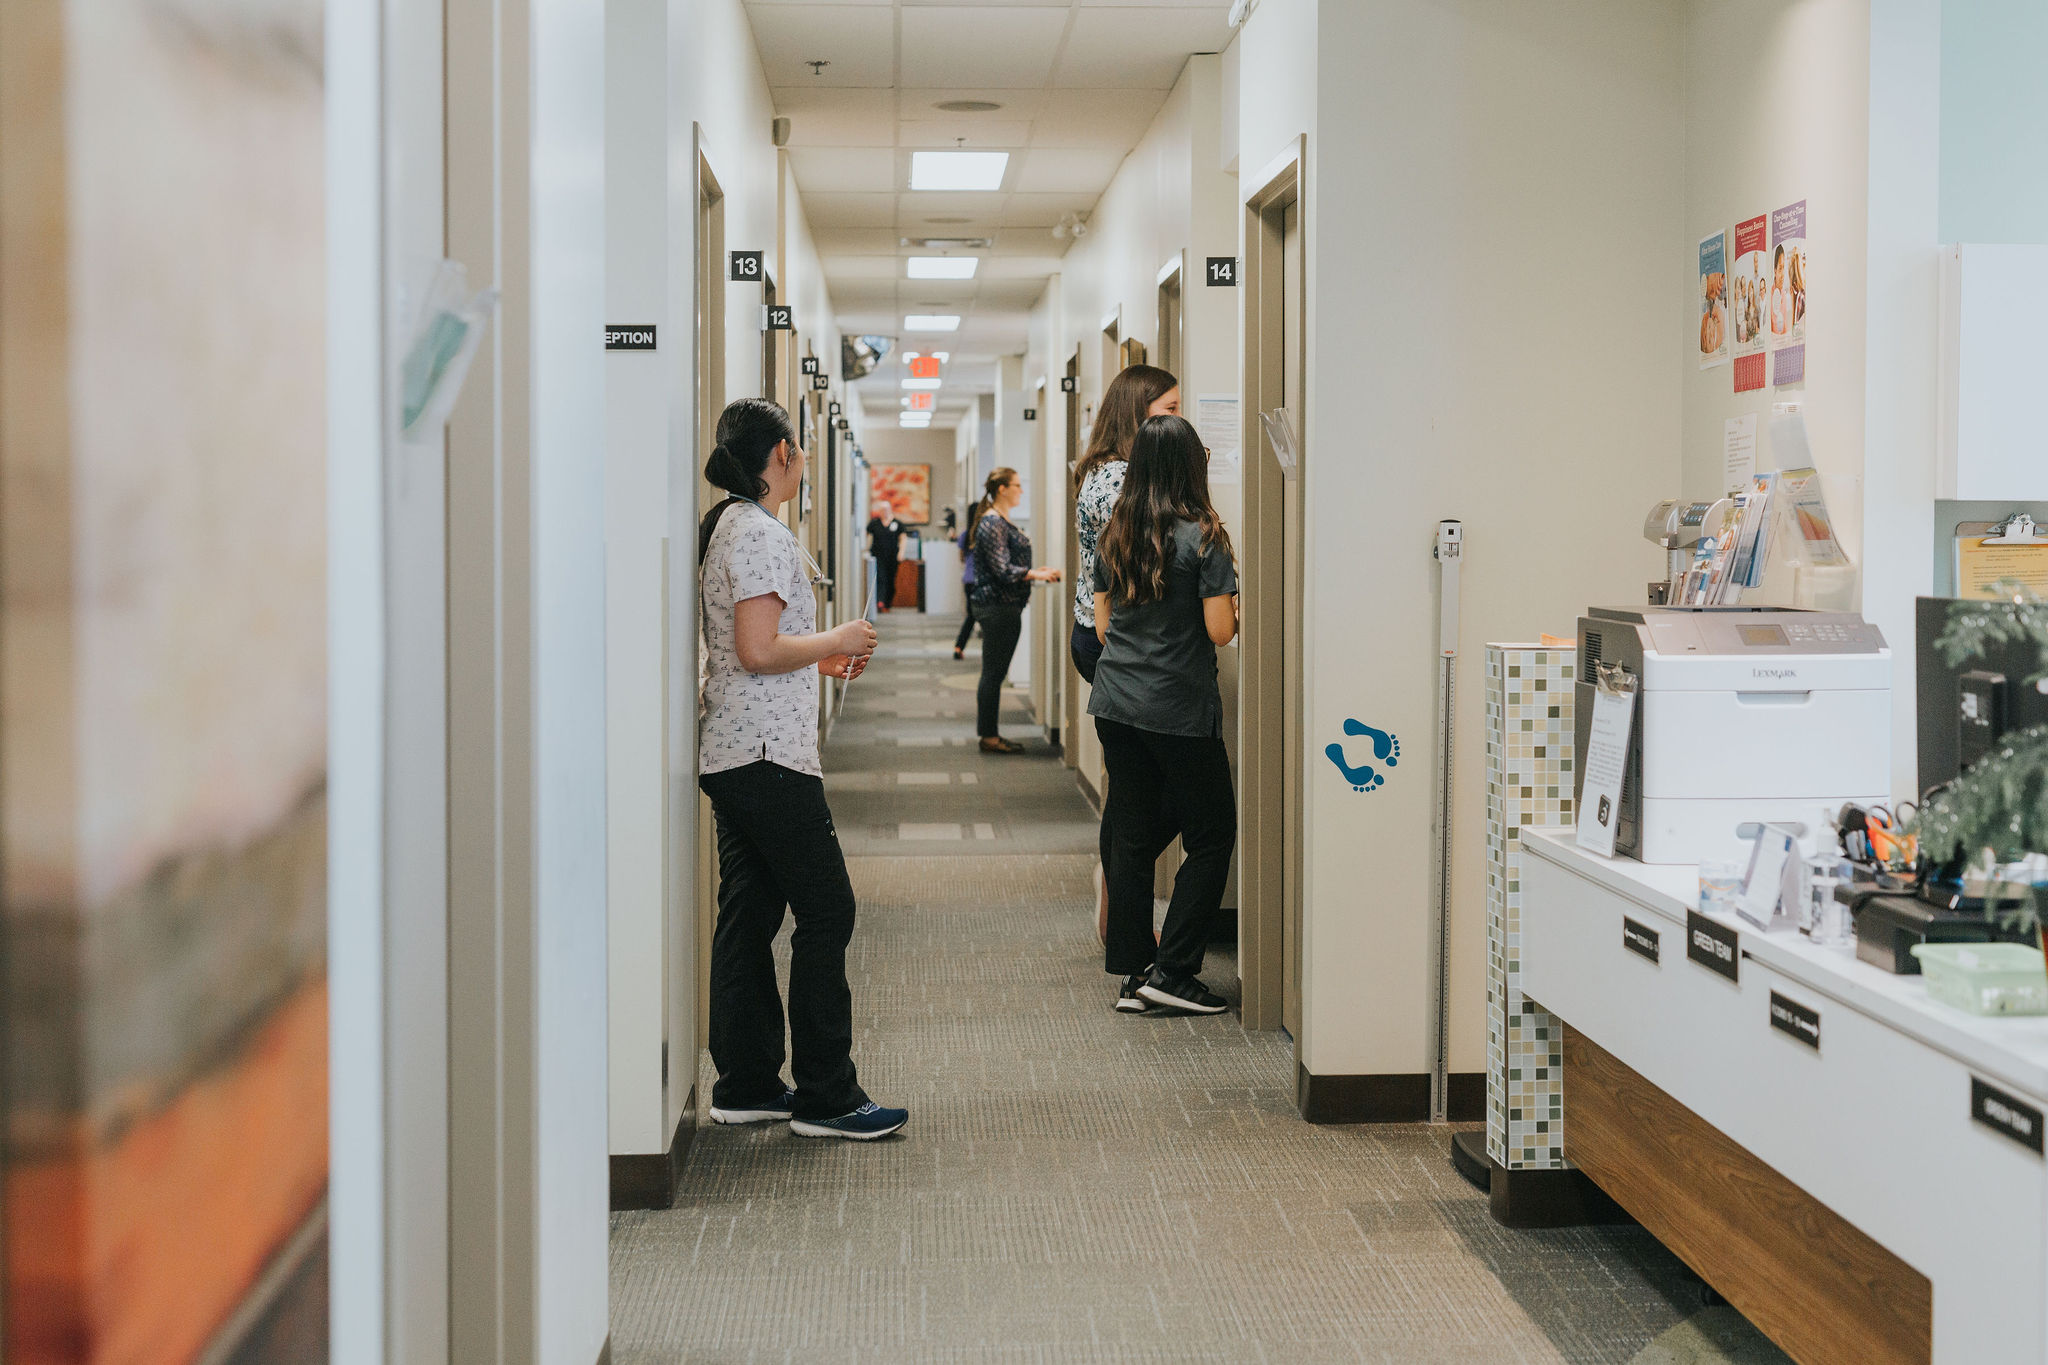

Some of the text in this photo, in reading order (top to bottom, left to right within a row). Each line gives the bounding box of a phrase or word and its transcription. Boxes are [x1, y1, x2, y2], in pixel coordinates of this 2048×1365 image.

[735, 257, 758, 275] 13
[1210, 263, 1232, 280] 14
[770, 310, 788, 325] 12
[804, 360, 817, 372] 11
[815, 377, 827, 389] 10
[1693, 929, 1733, 962] GREEN TEAM
